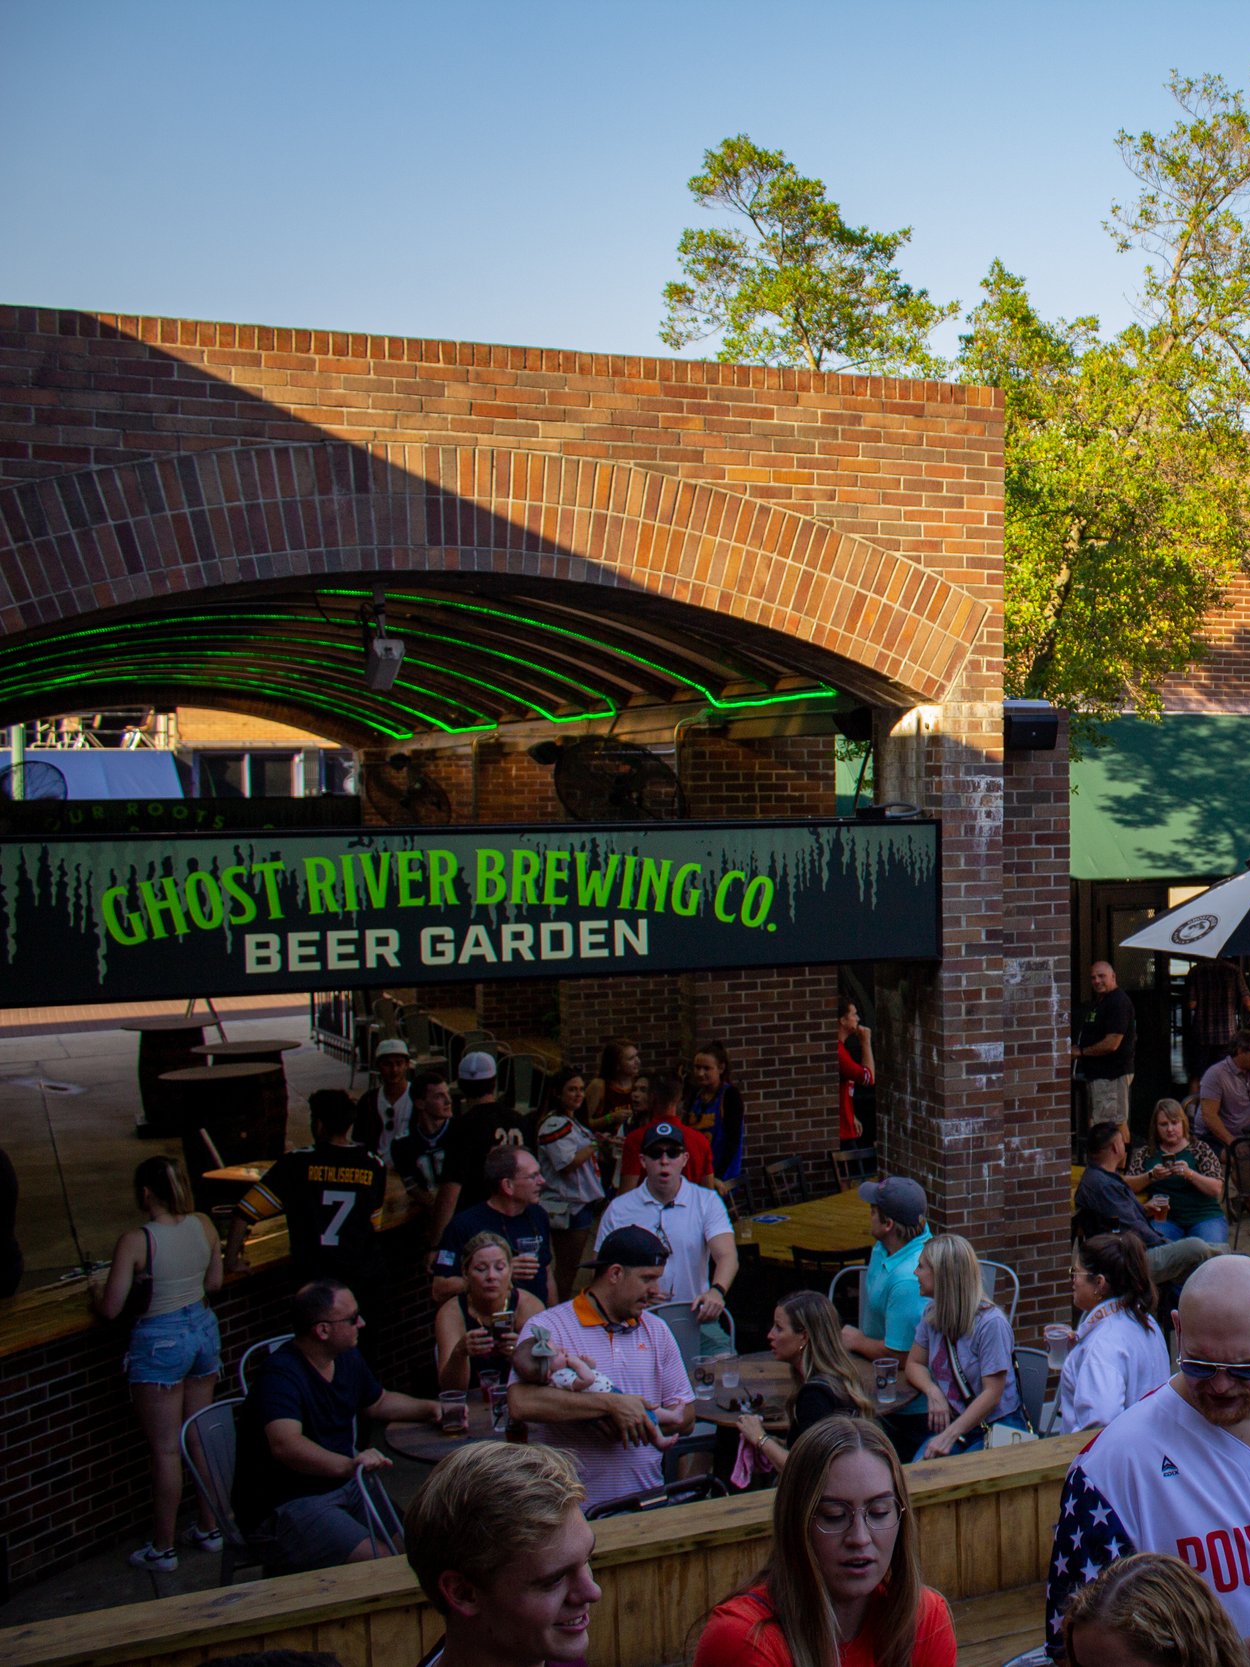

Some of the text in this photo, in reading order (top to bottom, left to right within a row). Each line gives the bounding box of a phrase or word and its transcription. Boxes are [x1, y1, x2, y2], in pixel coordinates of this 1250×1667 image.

[127, 802, 225, 830] ROOTS
[101, 848, 778, 947] GHOST RIVER BREWING CO.
[244, 918, 649, 975] BEER GARDEN
[320, 1189, 357, 1247] 7
